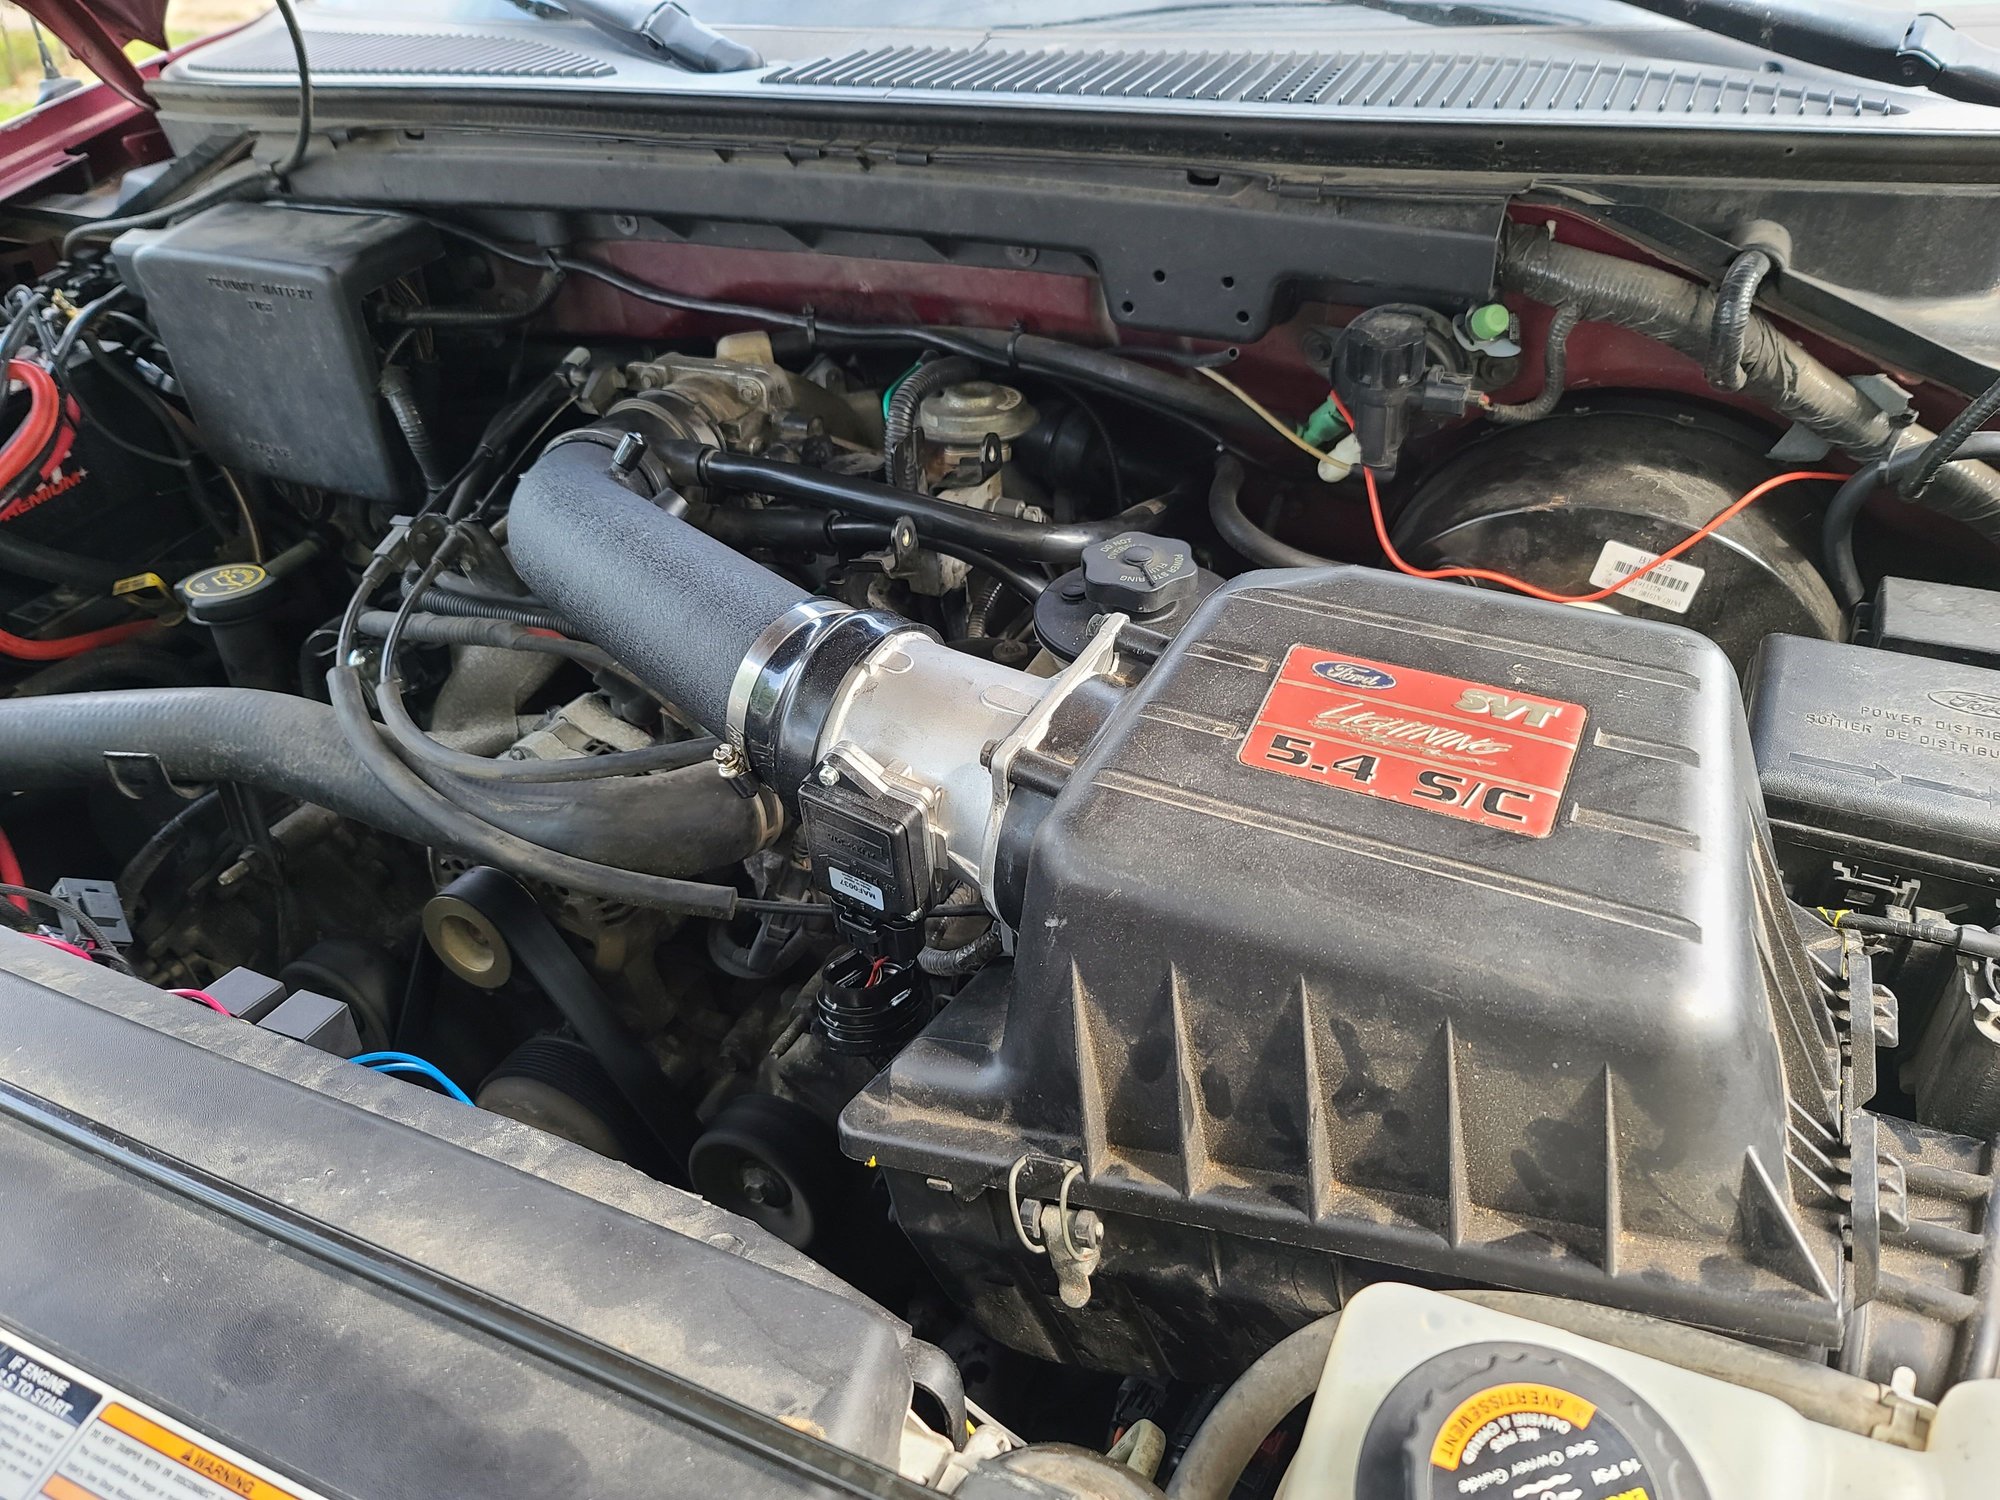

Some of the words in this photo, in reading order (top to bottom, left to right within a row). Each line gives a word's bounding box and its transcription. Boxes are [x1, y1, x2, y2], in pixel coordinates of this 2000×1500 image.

[1324, 662, 1384, 687] Ford
[1452, 688, 1564, 728] SVT
[1861, 706, 1923, 726] POWER
[1885, 728, 1908, 741] DE
[1265, 733, 1381, 784] 5.4
[1410, 769, 1535, 823] S/C
[8, 1354, 27, 1371] IF
[20, 1361, 71, 1397] ENGINE
[14, 1377, 35, 1397] TO
[31, 1387, 75, 1418] START
[1441, 1388, 1565, 1457] AVERTISSEMENT
[1511, 1412, 1572, 1435] OUVRIR
[1516, 1427, 1541, 1442] NE
[1489, 1429, 1519, 1454] PAS
[1564, 1439, 1600, 1459] See
[194, 1453, 256, 1494] WARNING
[1511, 1450, 1565, 1478] Owner
[1457, 1467, 1510, 1495] Guide
